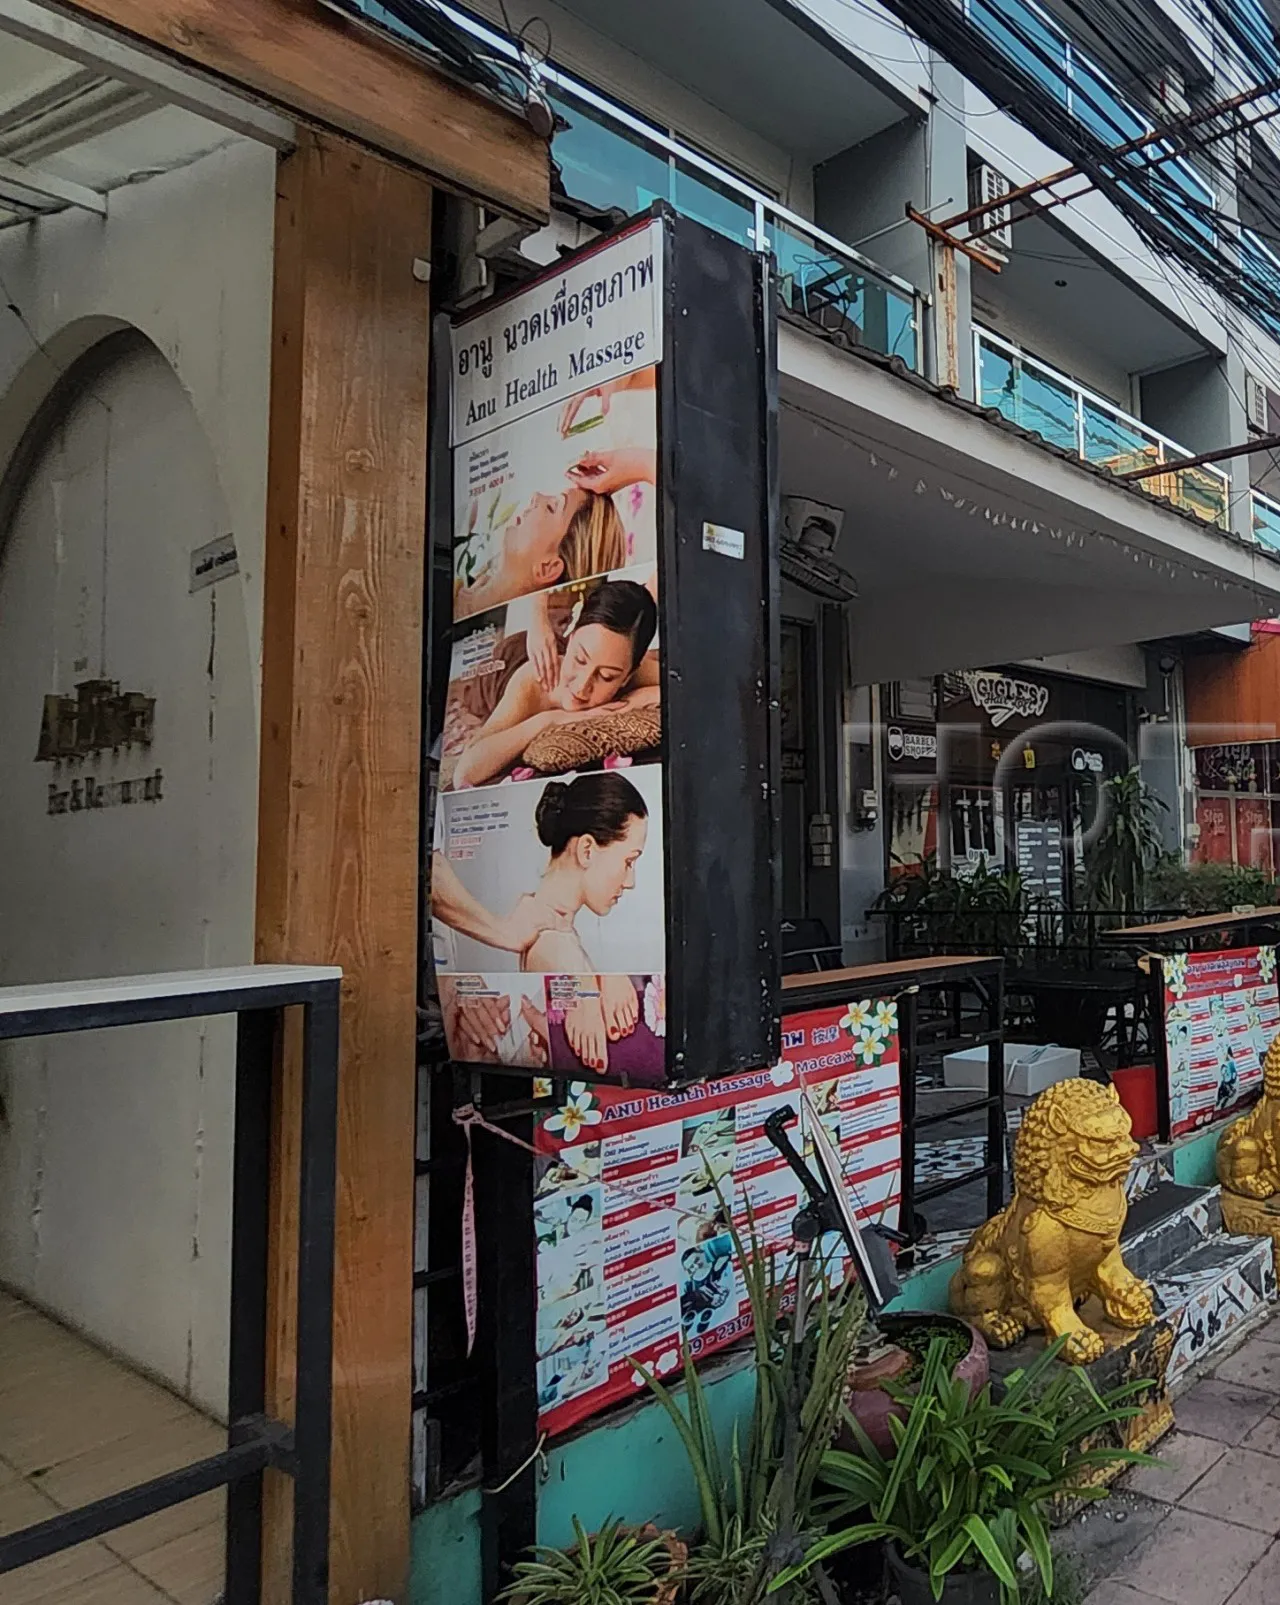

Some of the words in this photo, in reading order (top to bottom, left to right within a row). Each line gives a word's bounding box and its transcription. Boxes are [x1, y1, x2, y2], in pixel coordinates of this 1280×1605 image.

[465, 397, 497, 427] Anu
[505, 363, 559, 409] Health
[568, 329, 645, 381] Massage
[905, 736, 937, 746] BARBER
[968, 849, 989, 862] Opn
[795, 1051, 854, 1074] Массаж
[604, 1100, 643, 1121] ANU
[647, 1087, 705, 1110] Health
[709, 1073, 772, 1097] Massage
[717, 1313, 753, 1342] 2317
